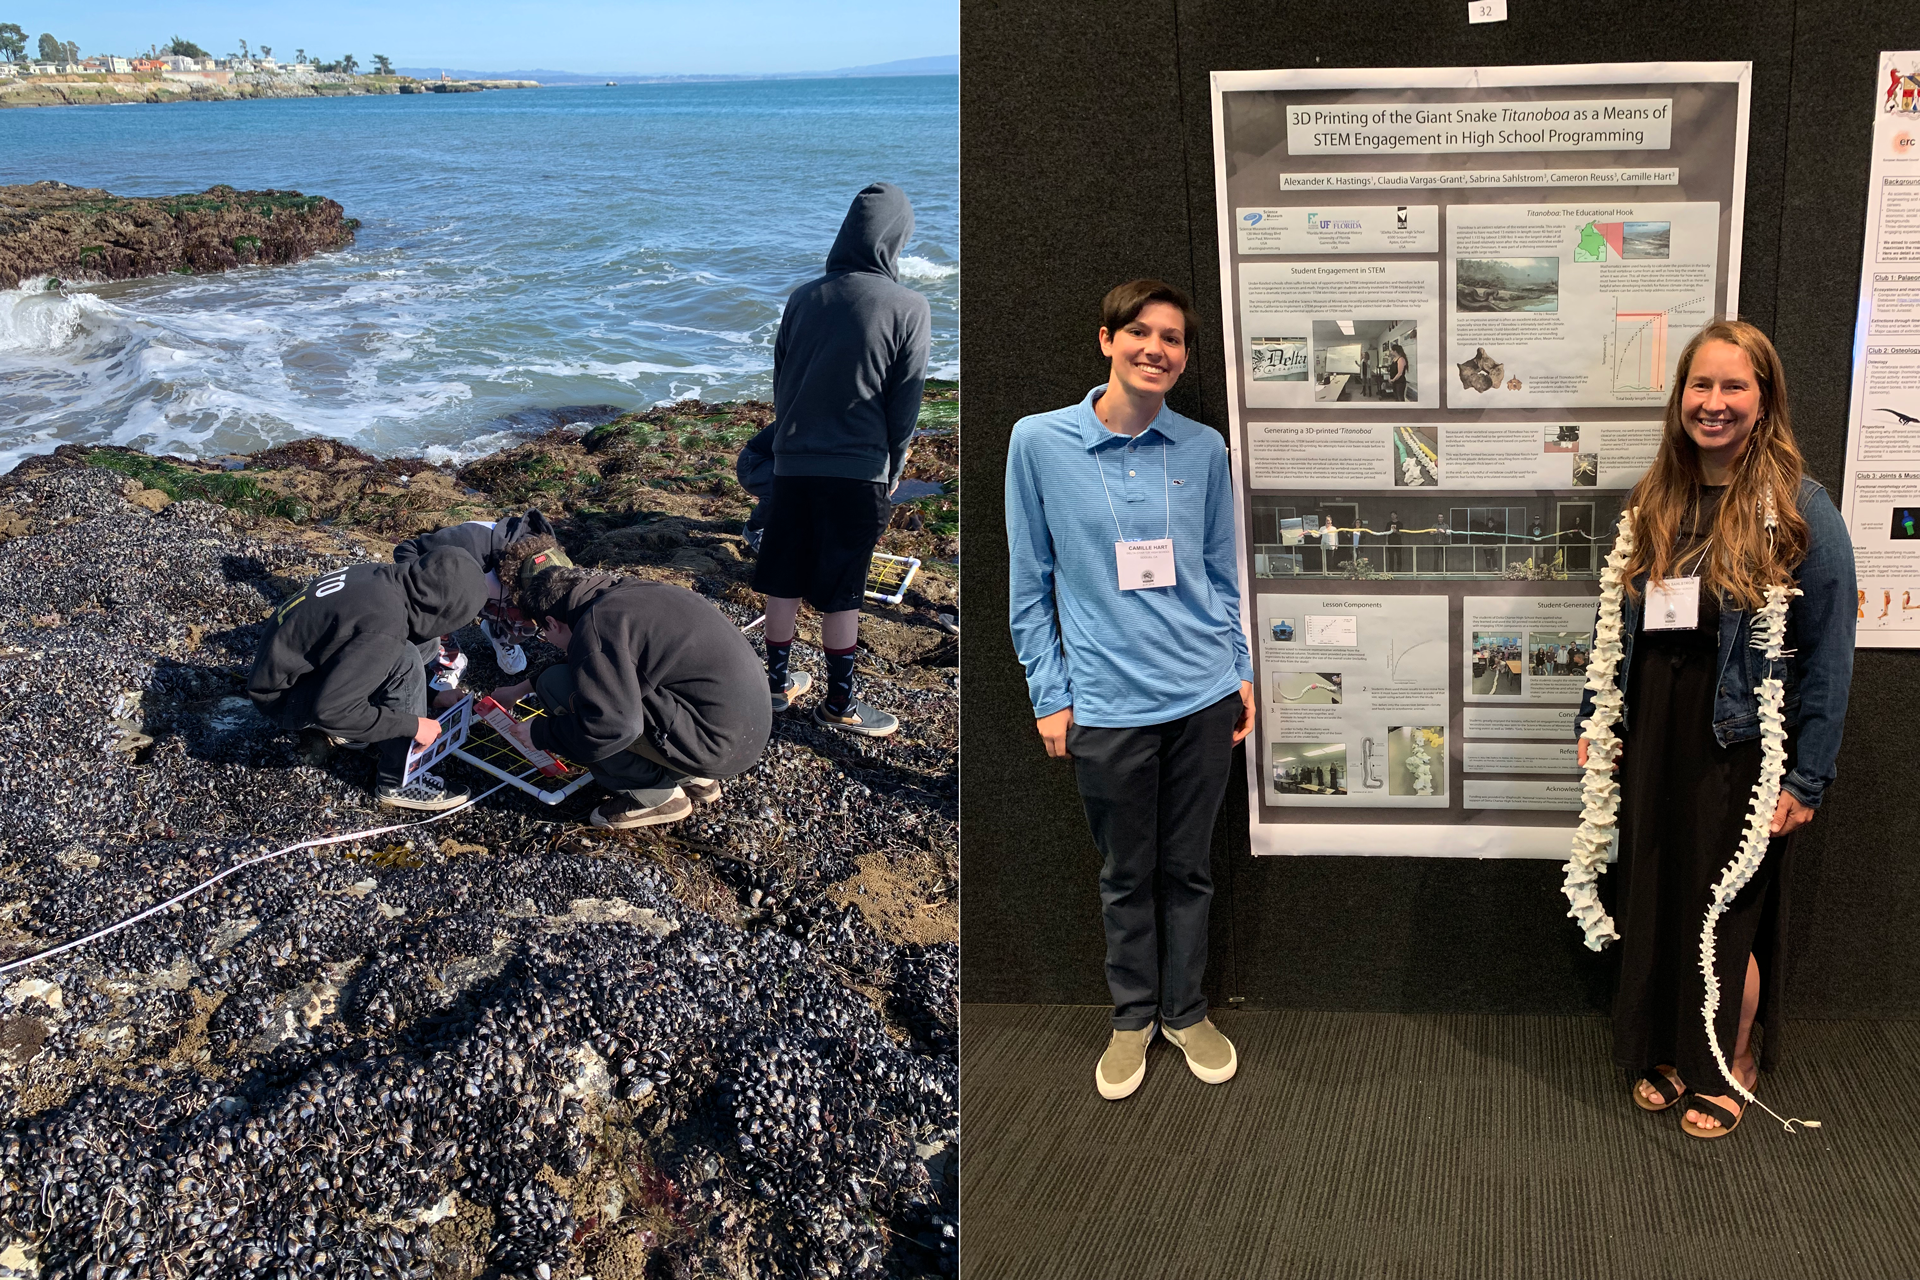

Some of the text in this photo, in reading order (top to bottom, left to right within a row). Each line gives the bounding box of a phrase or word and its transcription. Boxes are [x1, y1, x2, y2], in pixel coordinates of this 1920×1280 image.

[1480, 6, 1492, 16] 32
[1292, 105, 1667, 129] 3D Printing of the Giant Snake Titanoboa as a Means of
[1314, 128, 1644, 149] STEM Engagement in High School Programming
[1900, 138, 1915, 146] erc
[1283, 176, 1324, 186] Alexander
[1326, 176, 1334, 185] K.
[1377, 175, 1408, 185] Claudia
[1469, 174, 1500, 183] Sabrina
[1550, 173, 1588, 182] Cameron
[1620, 172, 1651, 182] Camille
[1320, 220, 1331, 229] UF
[1317, 267, 1358, 276] Engagement
[1267, 349, 1307, 367] Delta
[1264, 427, 1298, 436] Generating
[1305, 427, 1338, 436] 3D-printed
[315, 566, 349, 598] TO
